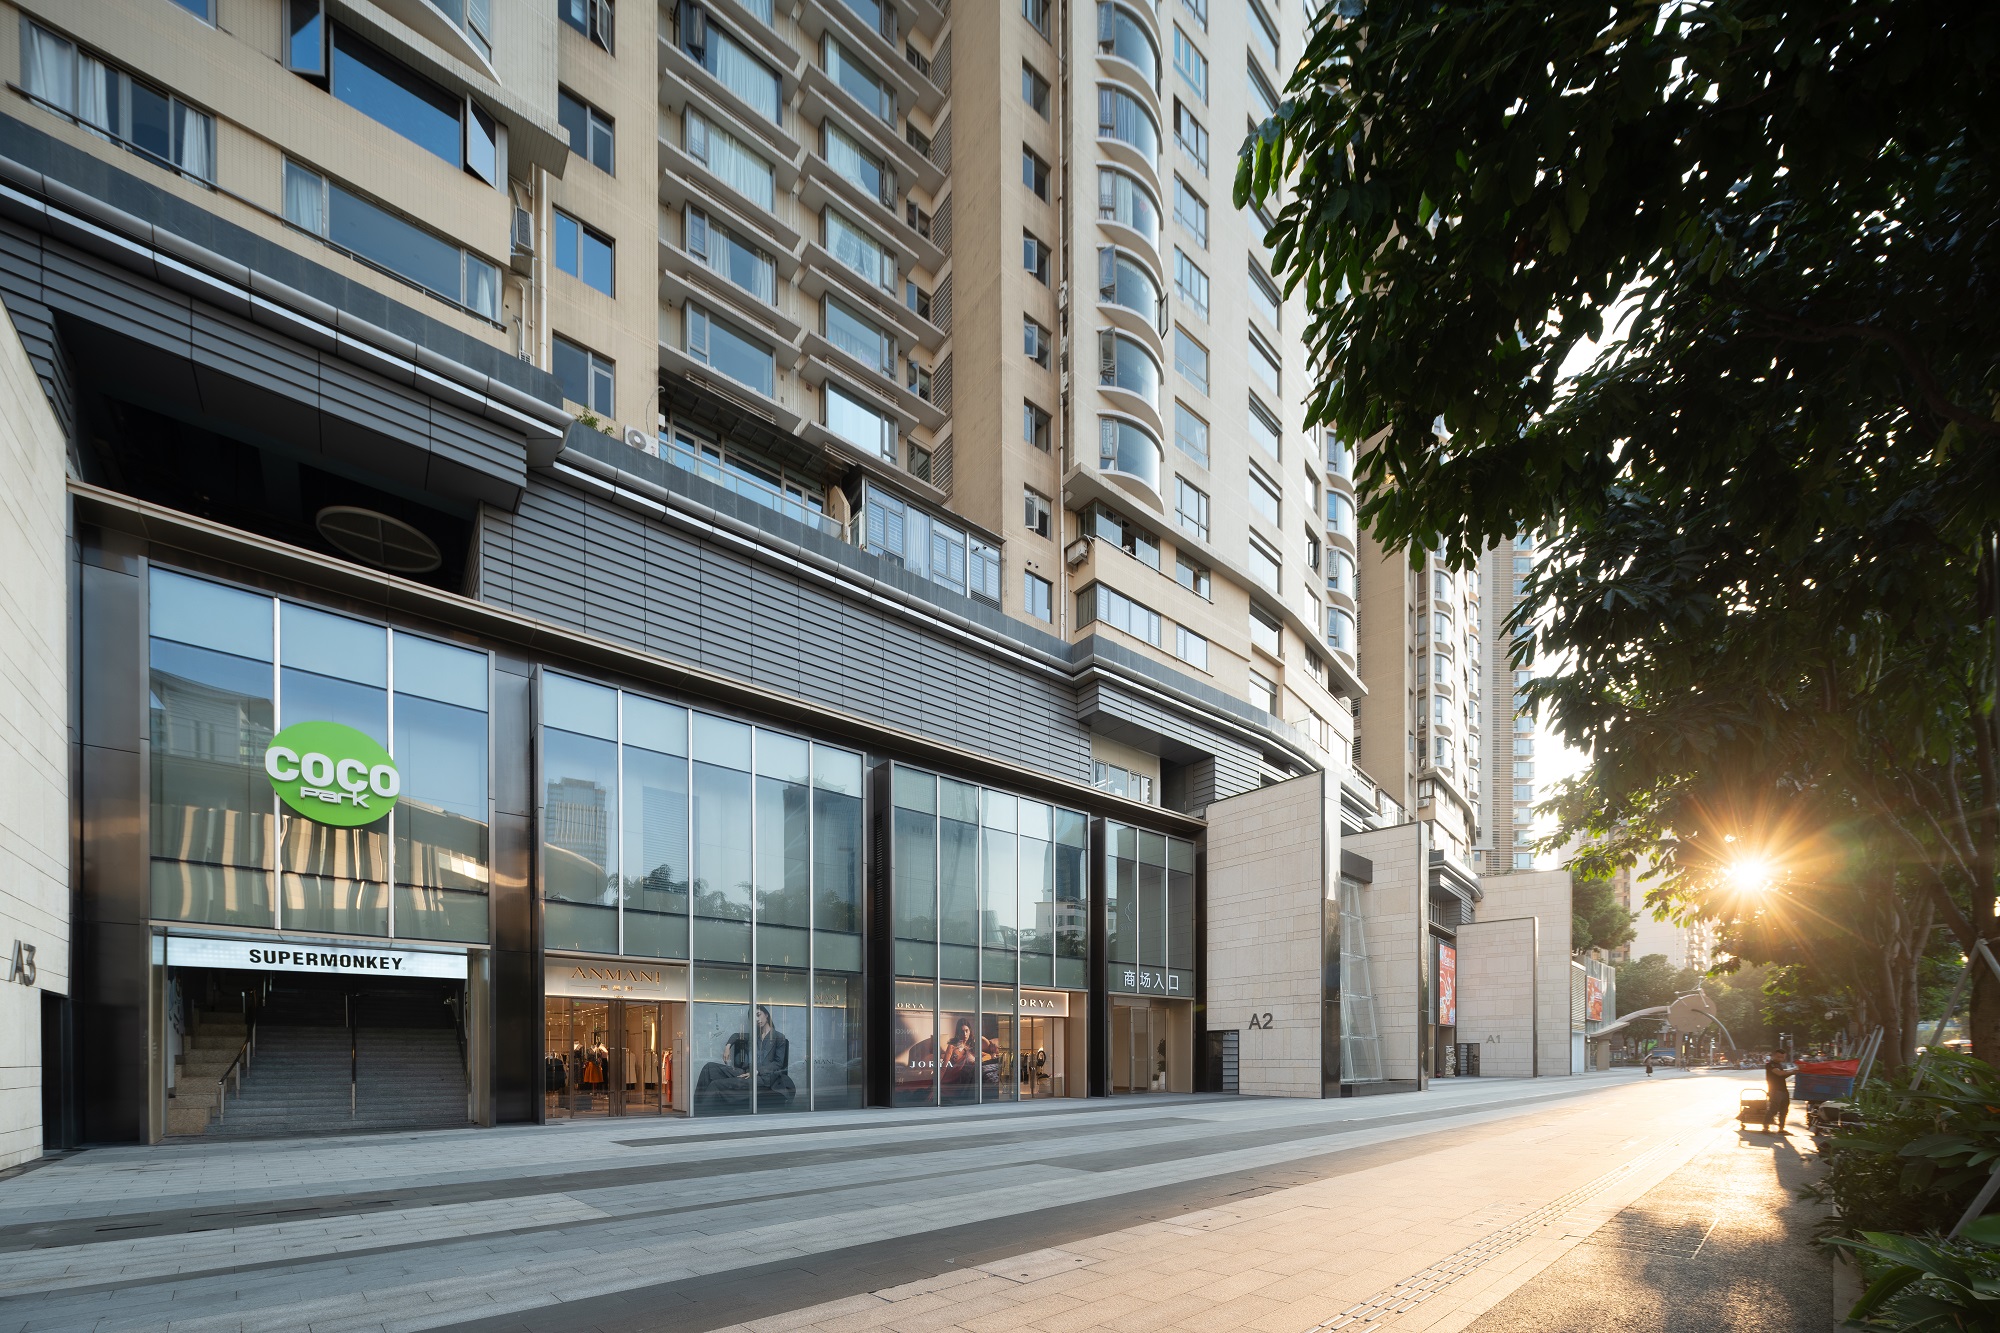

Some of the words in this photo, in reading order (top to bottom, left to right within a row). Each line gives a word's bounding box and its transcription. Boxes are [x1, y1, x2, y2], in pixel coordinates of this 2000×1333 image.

[265, 746, 400, 797] COCO
[9, 939, 37, 986] A3
[249, 949, 403, 970] SUPERMONKEY
[571, 966, 661, 983] ANMANI
[1123, 970, 1179, 991] 商场入口
[1011, 998, 1055, 1008] ORYA
[1248, 1012, 1274, 1030] A2
[1486, 1034, 1501, 1044] A1
